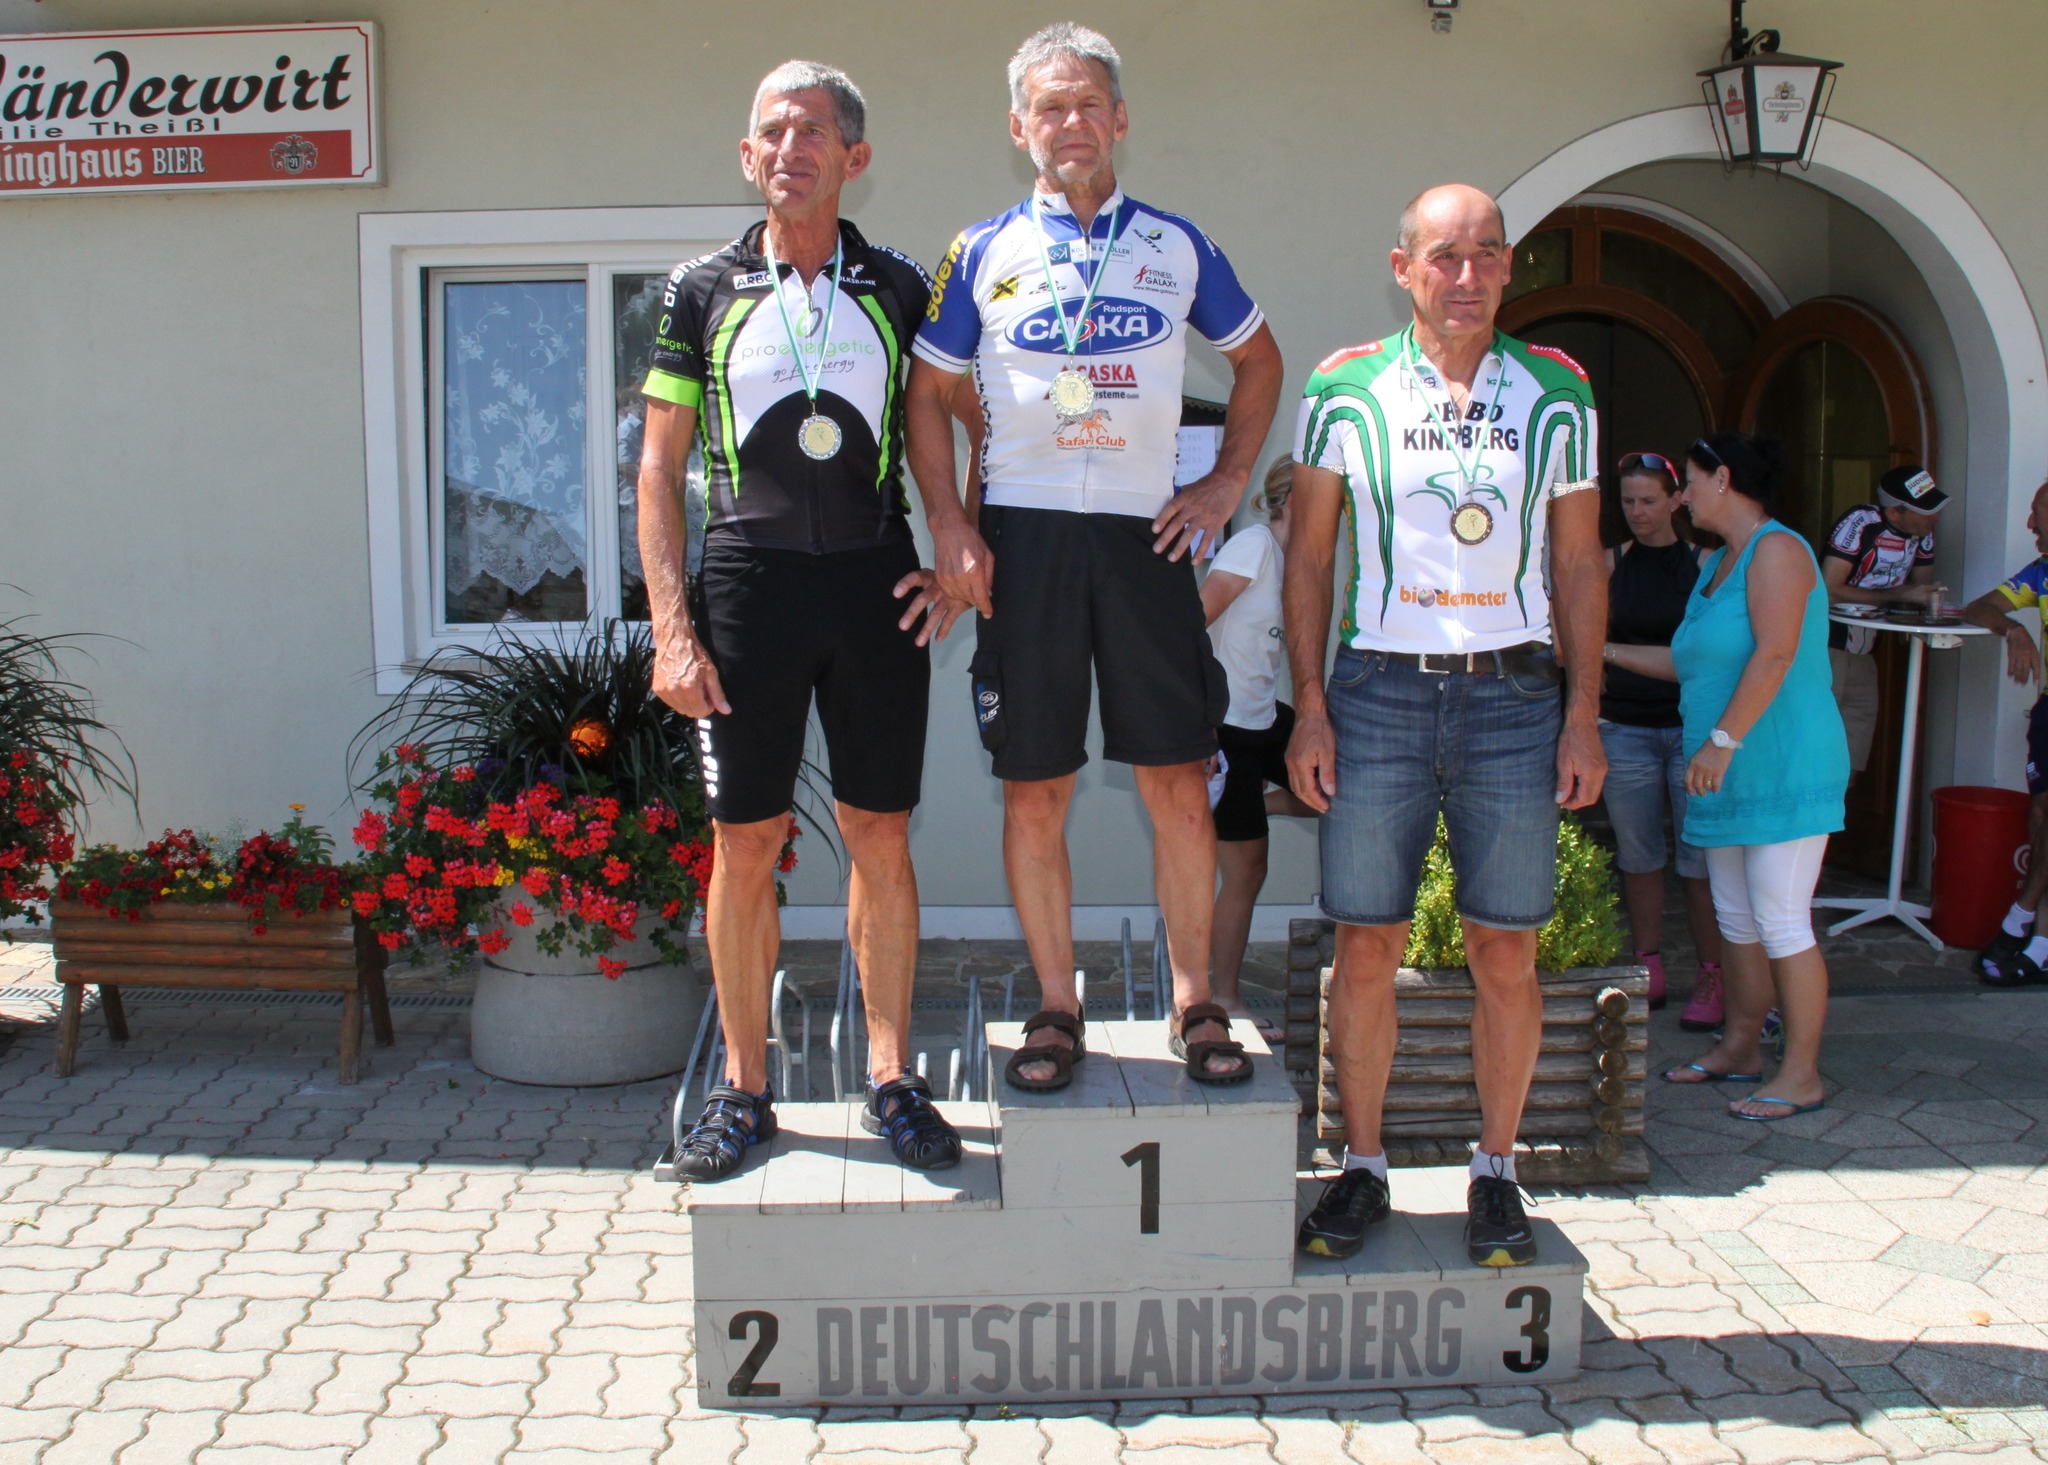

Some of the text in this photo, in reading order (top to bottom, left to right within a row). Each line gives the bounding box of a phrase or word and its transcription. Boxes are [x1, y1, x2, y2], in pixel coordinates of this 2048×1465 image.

[0, 50, 352, 122] änderwirt
[88, 118, 221, 136] Theißl
[152, 146, 206, 175] BIER
[836, 274, 877, 287] OLKSBANK
[1145, 276, 1178, 289] GALAXY
[1148, 269, 1173, 280] FITNESS
[1103, 305, 1148, 314] Radsport
[1056, 435, 1127, 447] Safari Club
[1120, 1142, 1161, 1235] 1
[1503, 1286, 1552, 1374] 3
[727, 1310, 781, 1397] 2
[816, 1287, 1466, 1397] DEUTSCHLANDSBERG
